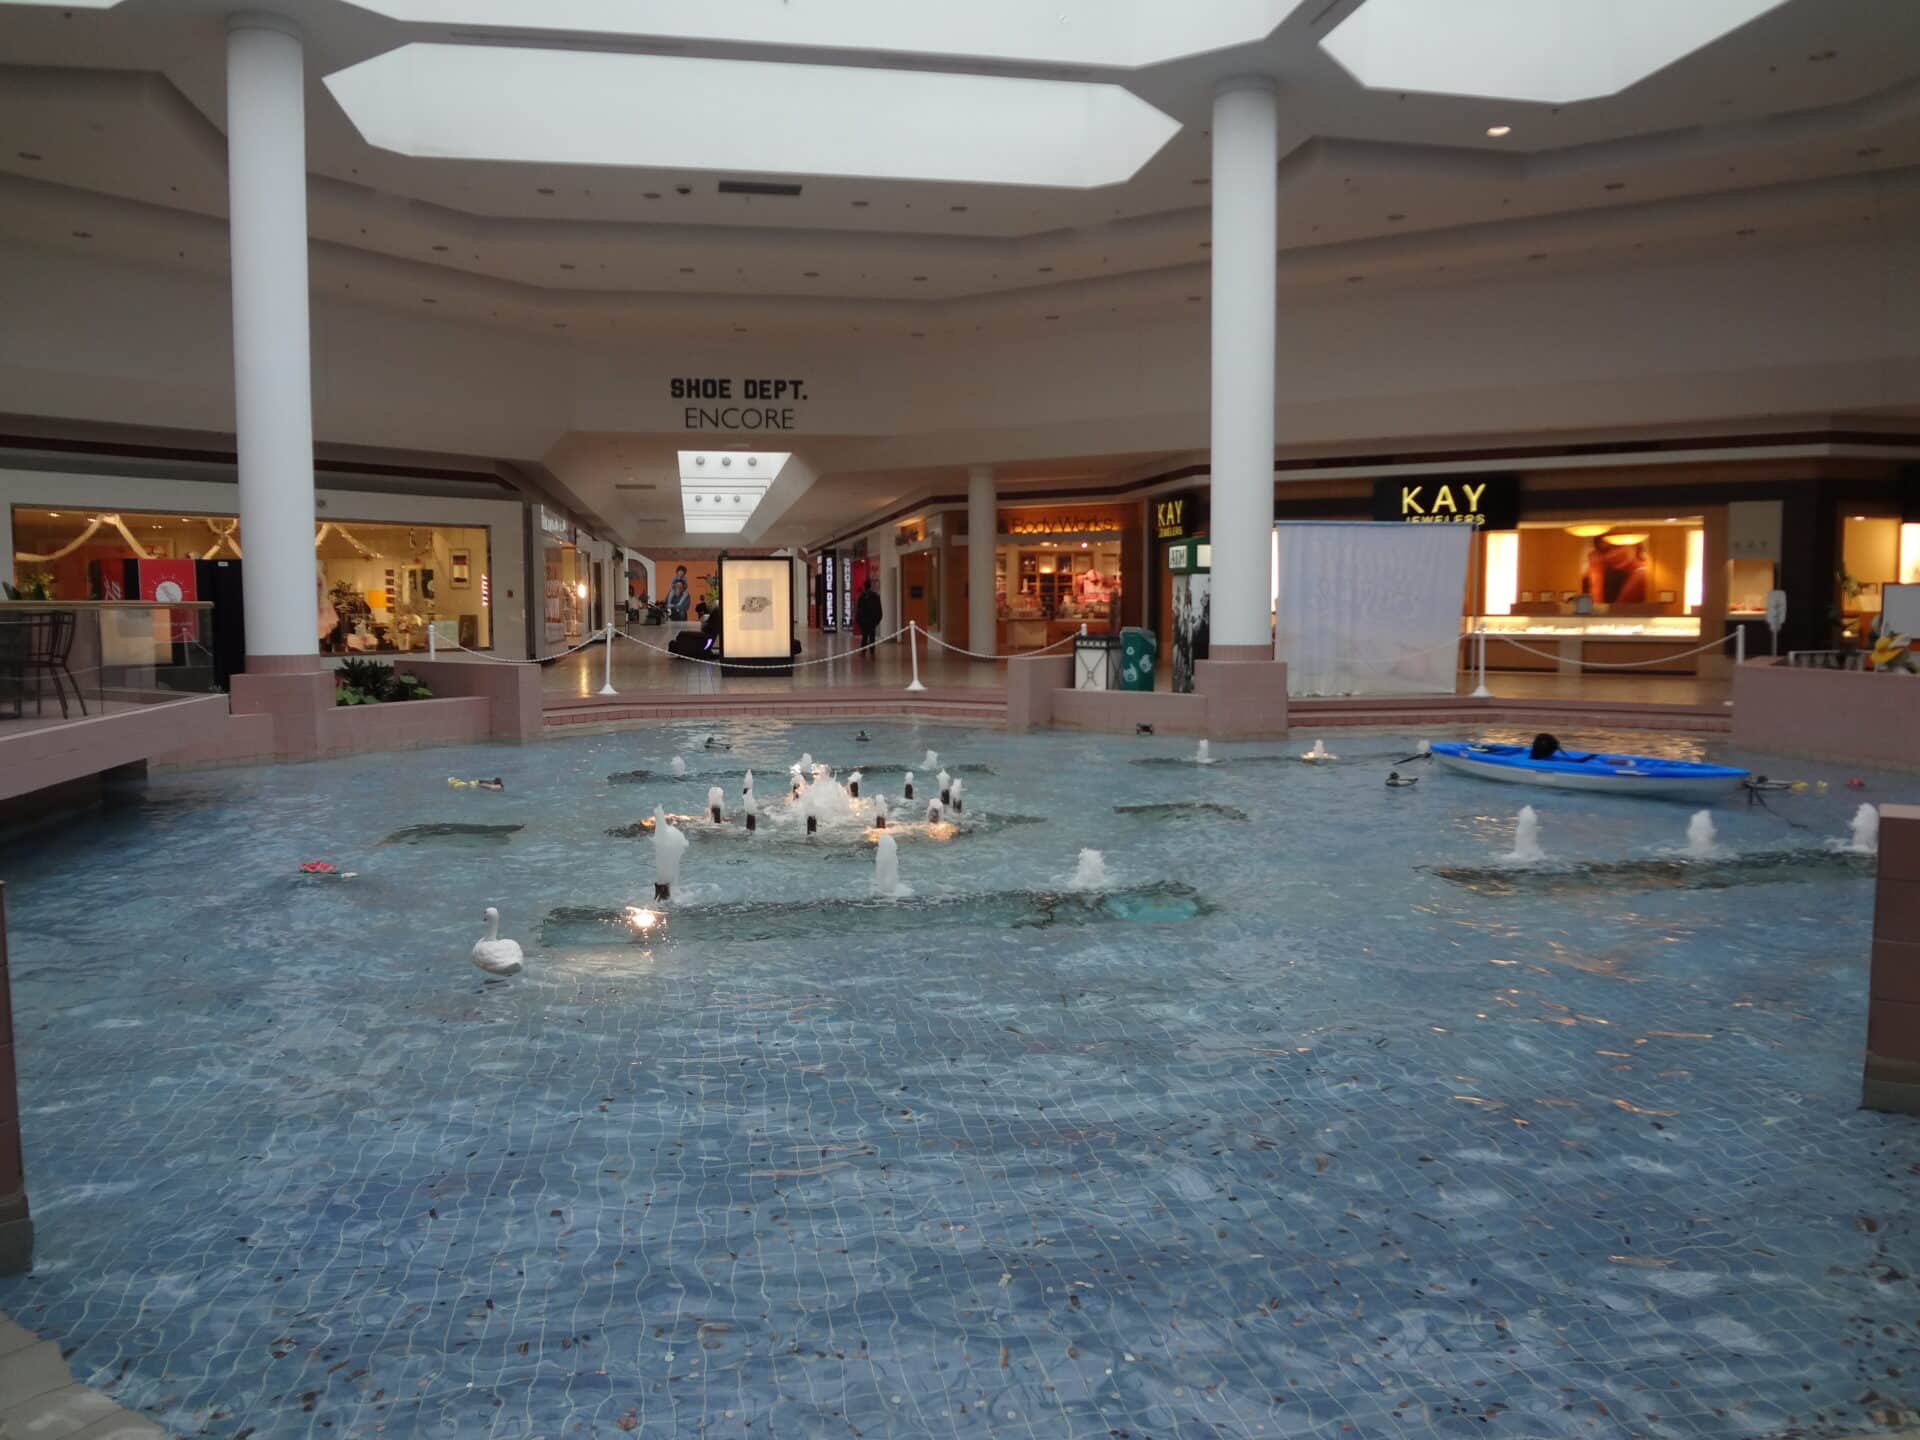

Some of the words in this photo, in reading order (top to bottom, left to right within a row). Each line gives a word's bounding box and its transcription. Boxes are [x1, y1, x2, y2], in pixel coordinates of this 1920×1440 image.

[671, 378, 731, 399] SHOE
[744, 379, 808, 400] DEPT.
[685, 407, 795, 429] ENCORE
[1401, 483, 1487, 514] KAY
[1157, 500, 1183, 527] KAY
[1170, 549, 1185, 565] ATM
